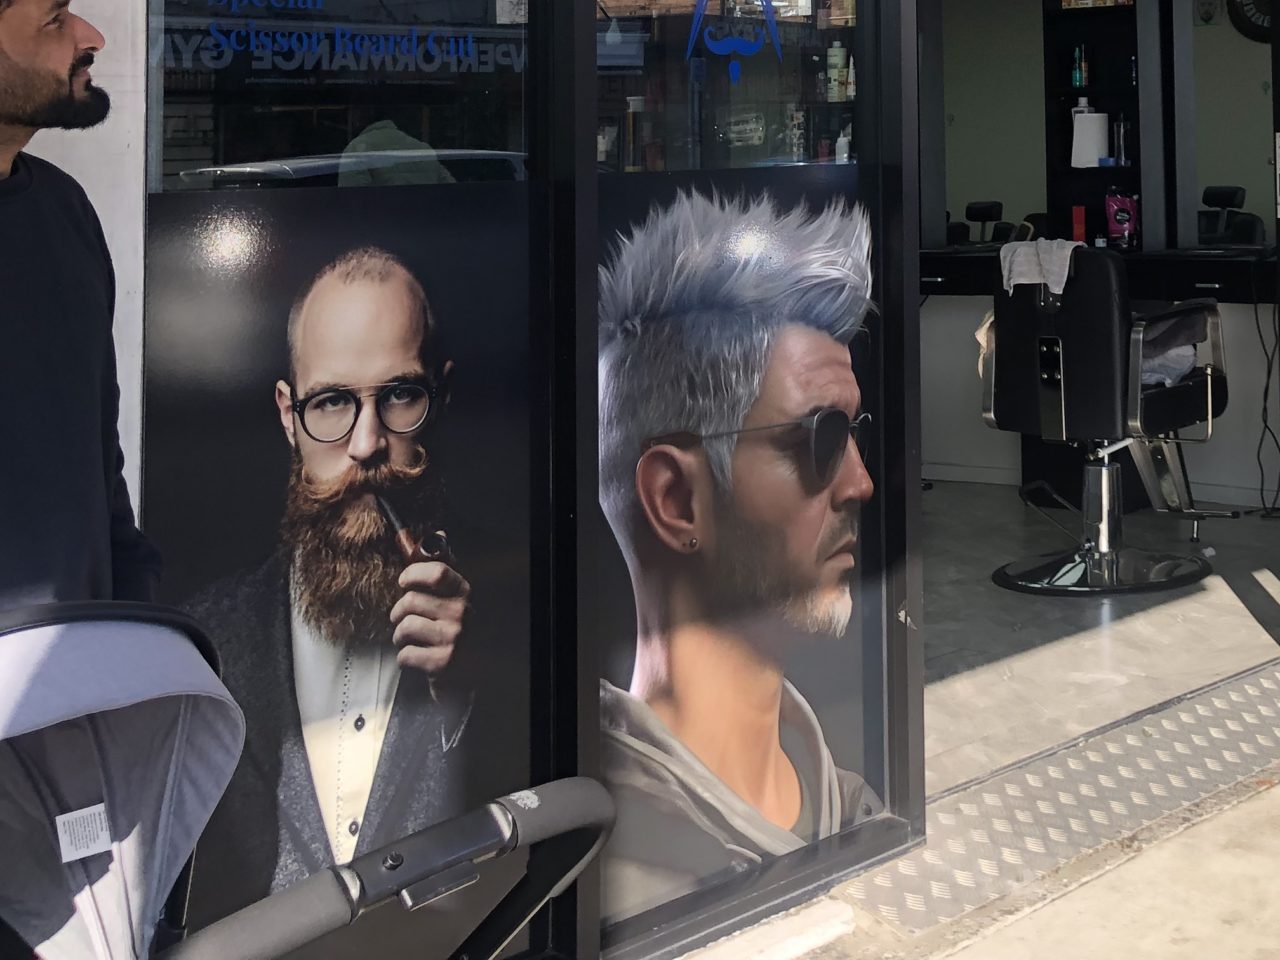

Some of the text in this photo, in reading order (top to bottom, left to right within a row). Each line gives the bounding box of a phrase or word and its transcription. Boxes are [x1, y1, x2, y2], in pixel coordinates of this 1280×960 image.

[208, 20, 476, 59] Scissor Beard Cut
